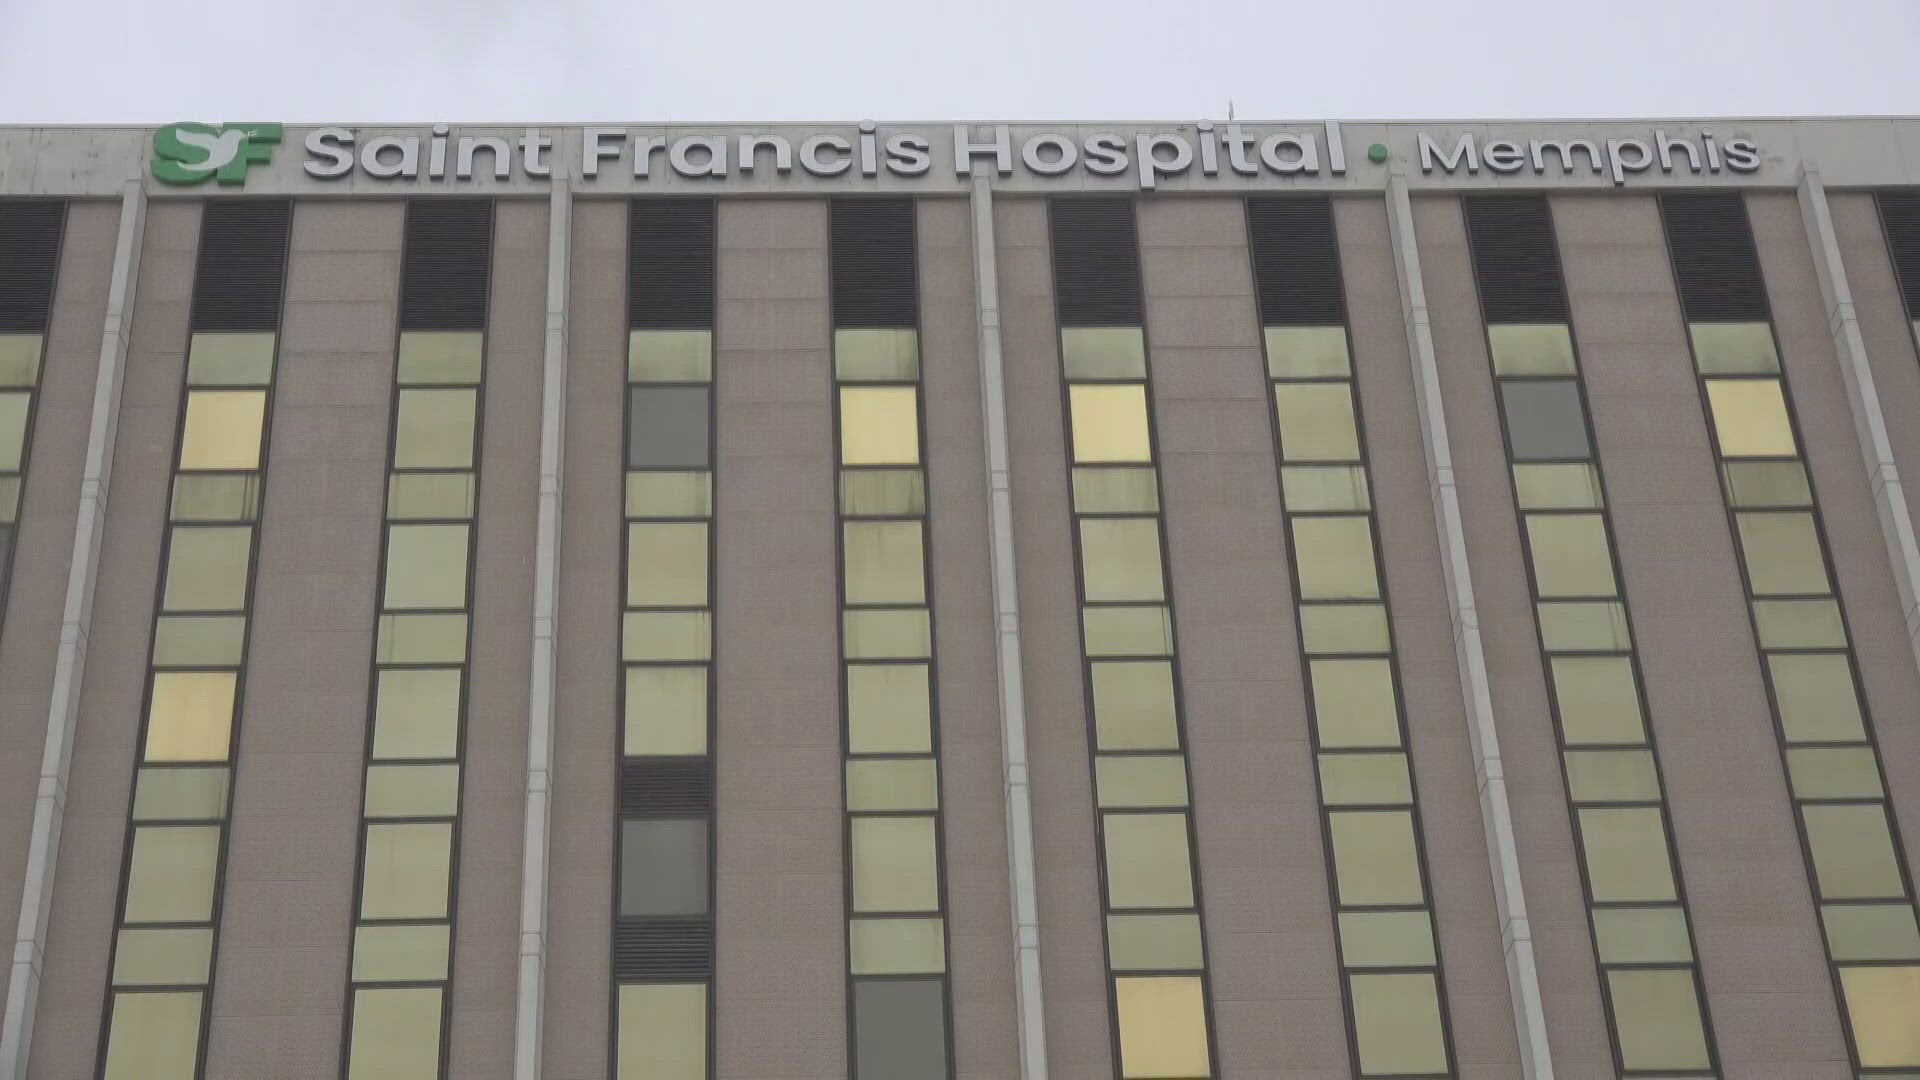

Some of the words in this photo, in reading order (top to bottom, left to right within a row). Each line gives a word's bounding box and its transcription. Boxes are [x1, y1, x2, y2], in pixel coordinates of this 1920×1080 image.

[150, 122, 282, 185] SF
[304, 122, 552, 180] Saint
[583, 119, 931, 177] Francis
[954, 119, 1346, 190] Hospital
[1417, 127, 1761, 184] Memphis
